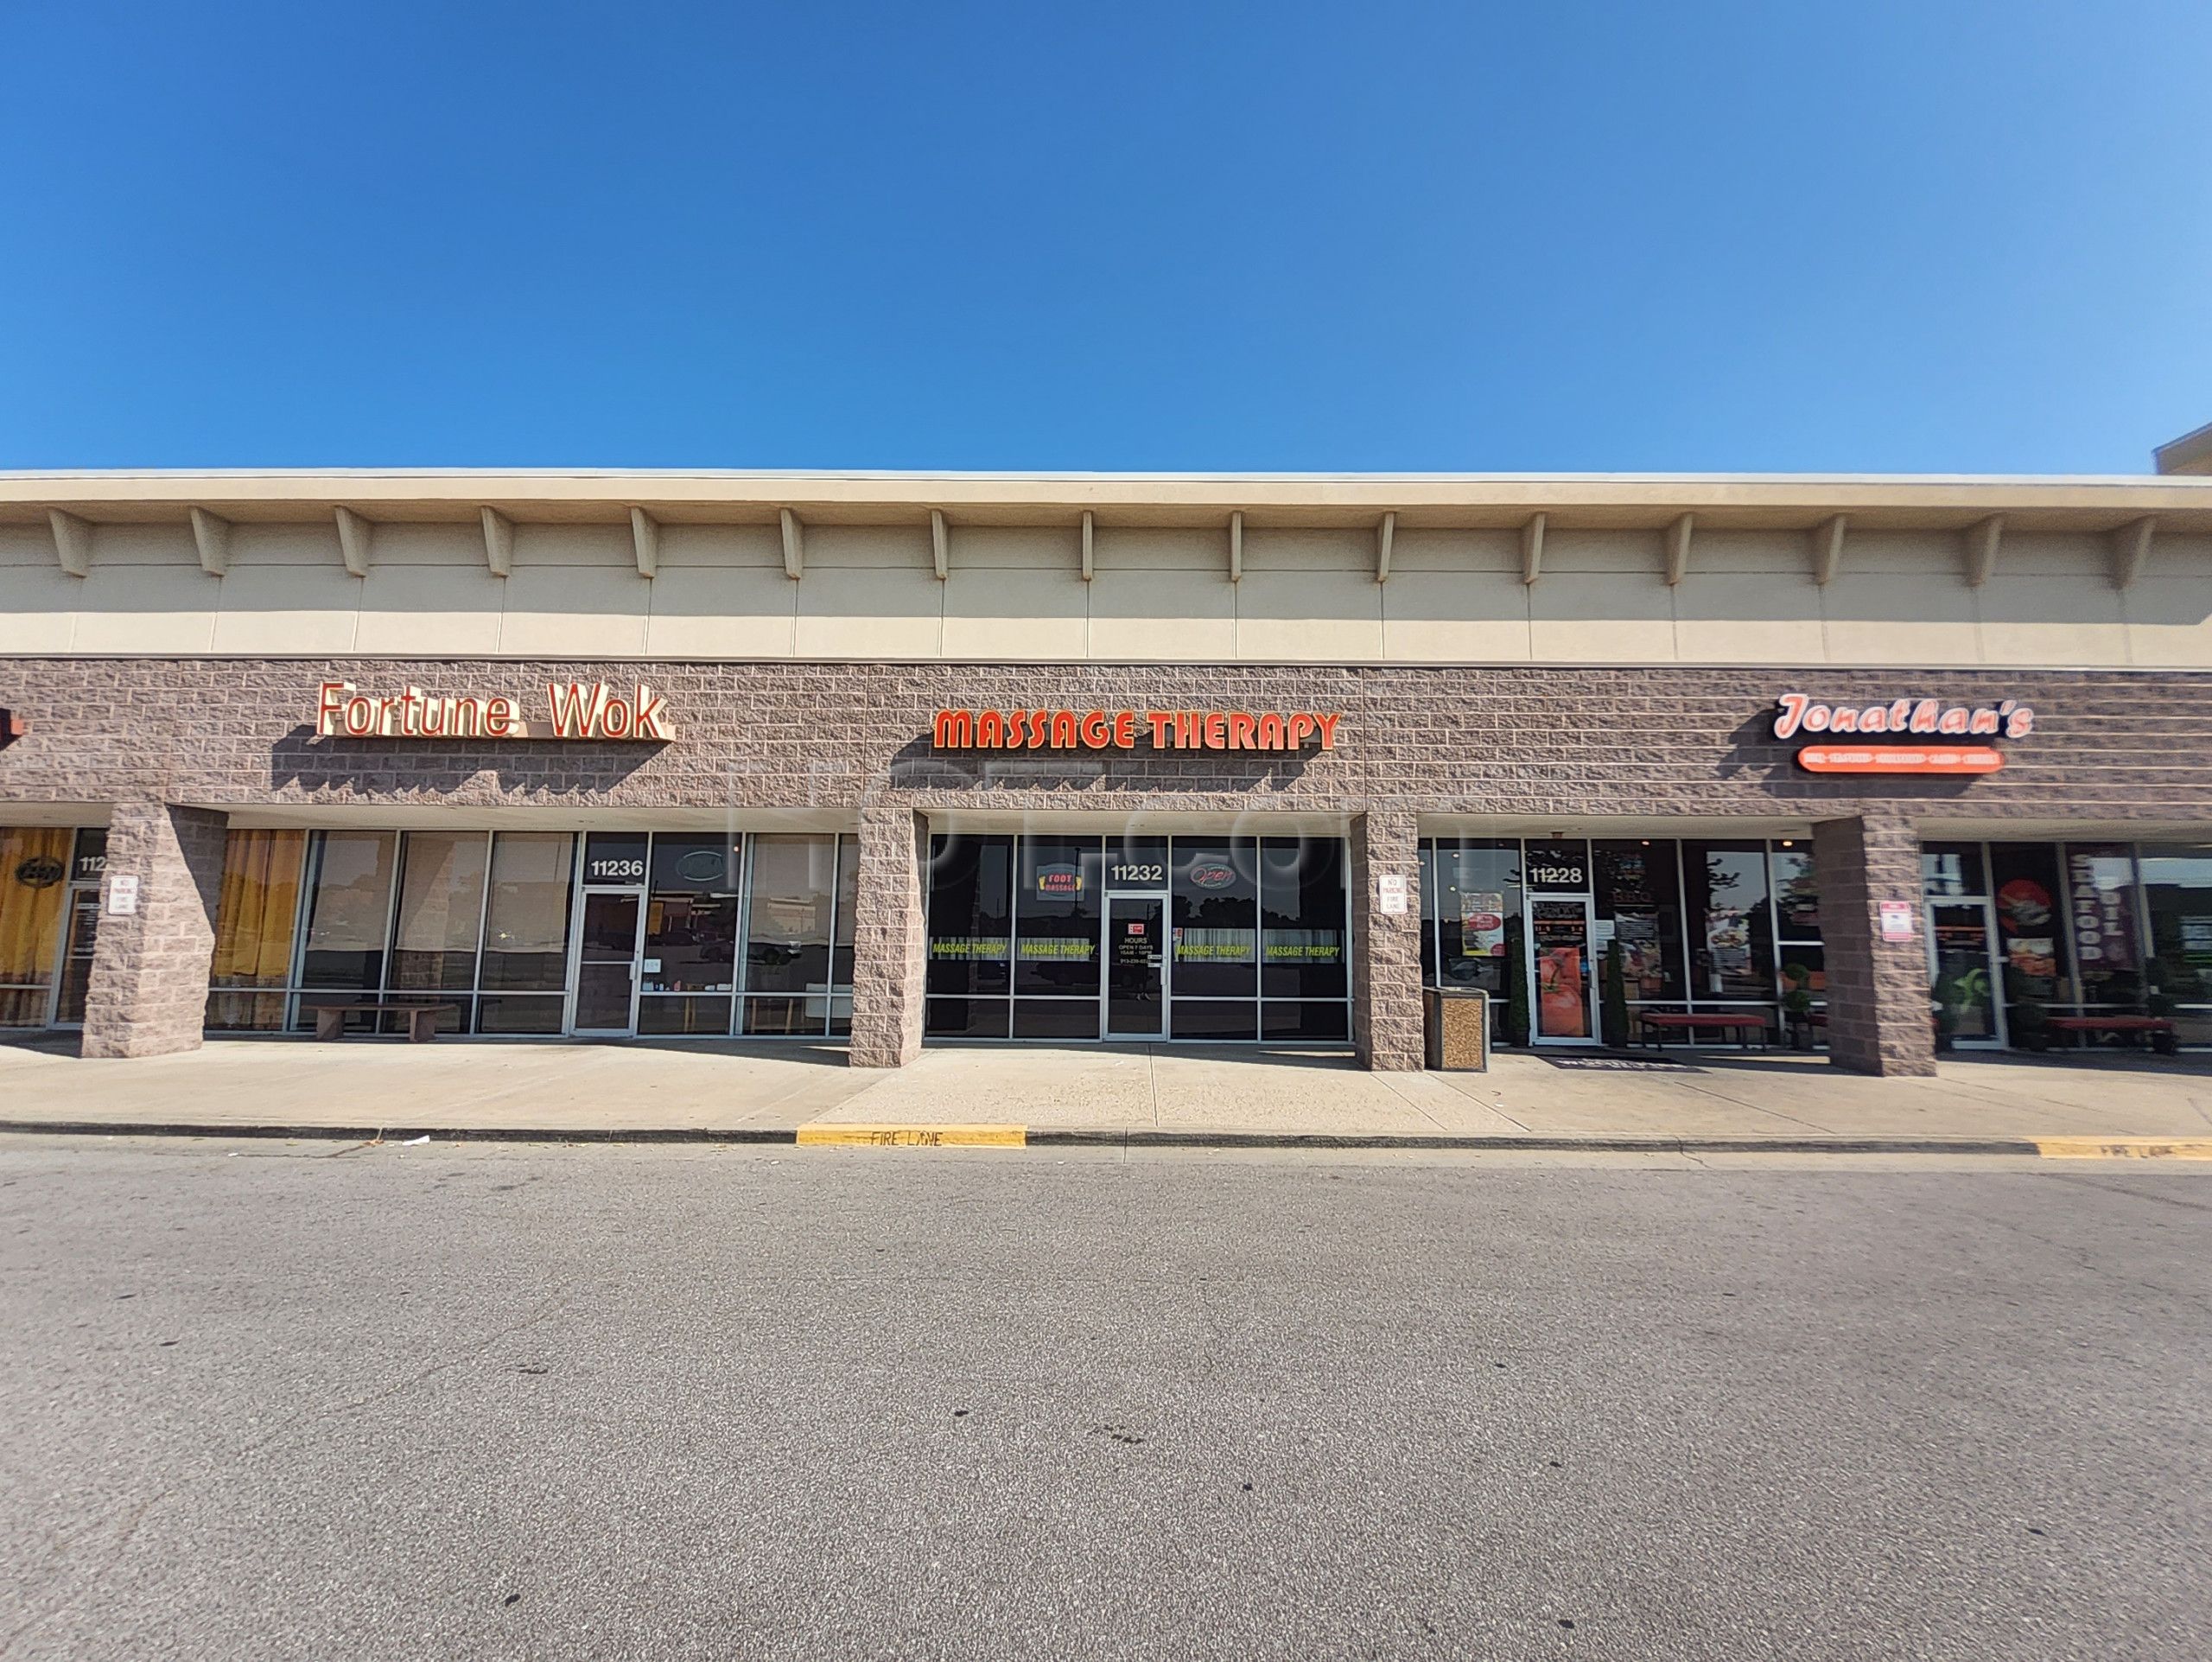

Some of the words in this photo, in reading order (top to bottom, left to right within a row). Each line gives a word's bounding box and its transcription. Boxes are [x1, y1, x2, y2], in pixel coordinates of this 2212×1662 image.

[316, 680, 519, 738] Fortune
[547, 680, 668, 740] Wok
[1774, 693, 2035, 738] Jonathan's
[933, 710, 1135, 749] MASSAGE
[1146, 710, 1341, 750] THERAPY
[79, 856, 109, 871] 112
[591, 860, 644, 876] 11236
[1048, 874, 1072, 882] FOOT
[1111, 865, 1163, 881] 11232
[1191, 867, 1234, 885] Open
[1529, 867, 1583, 883] 11228
[2070, 853, 2103, 961] SEAFOOD
[932, 943, 969, 953] MASSAGE
[971, 943, 1007, 953] THERAPY
[1020, 944, 1058, 955] MASSAGE
[1060, 945, 1096, 955] THERAPY
[1176, 945, 1213, 956] MASSAGE
[1216, 945, 1251, 956] THERAPY
[1266, 946, 1303, 957] MASSAGE
[1305, 946, 1340, 957] THERAPY
[870, 1130, 899, 1146] FIRE
[906, 1130, 944, 1147] LANE
